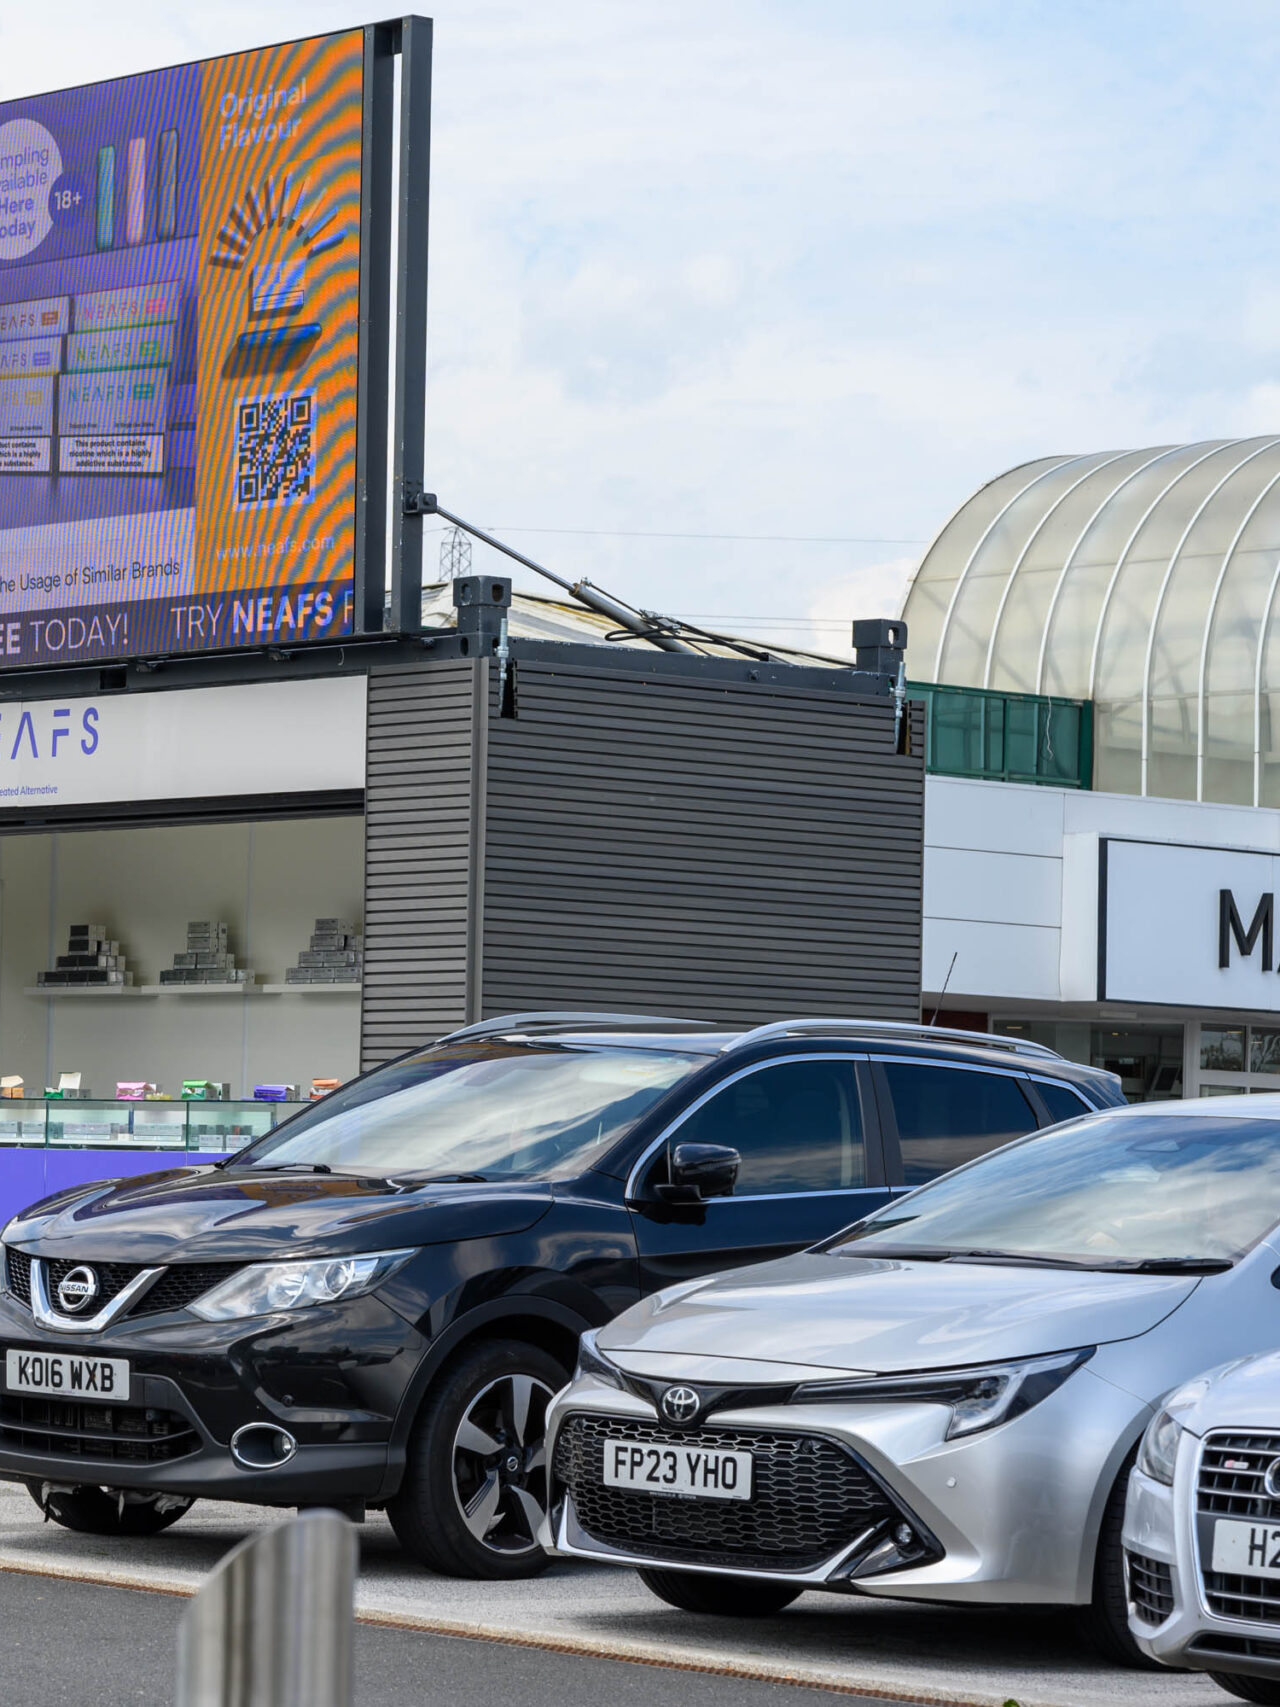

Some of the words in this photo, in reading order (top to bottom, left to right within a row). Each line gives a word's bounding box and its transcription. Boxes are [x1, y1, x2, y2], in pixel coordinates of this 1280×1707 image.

[220, 77, 306, 119] Original
[220, 118, 302, 150] Flavour
[54, 190, 81, 210] 18+
[90, 440, 114, 448] product
[117, 438, 146, 447] contains
[97, 449, 116, 457] which
[131, 449, 152, 458] highly
[216, 536, 335, 561] www.neafs.com
[20, 573, 61, 593] Usage
[65, 568, 79, 586] of
[82, 563, 127, 584] Similar
[131, 557, 180, 579] Brands
[29, 612, 128, 652] TODAY!
[170, 602, 223, 640] TRY
[233, 590, 333, 634] NEAFS
[20, 784, 58, 796] Alternative
[60, 1283, 89, 1293] NISSAN
[18, 1356, 63, 1388] KO16
[71, 1360, 114, 1393] WXB
[614, 1445, 677, 1484] FP23
[686, 1452, 738, 1490] YHO
